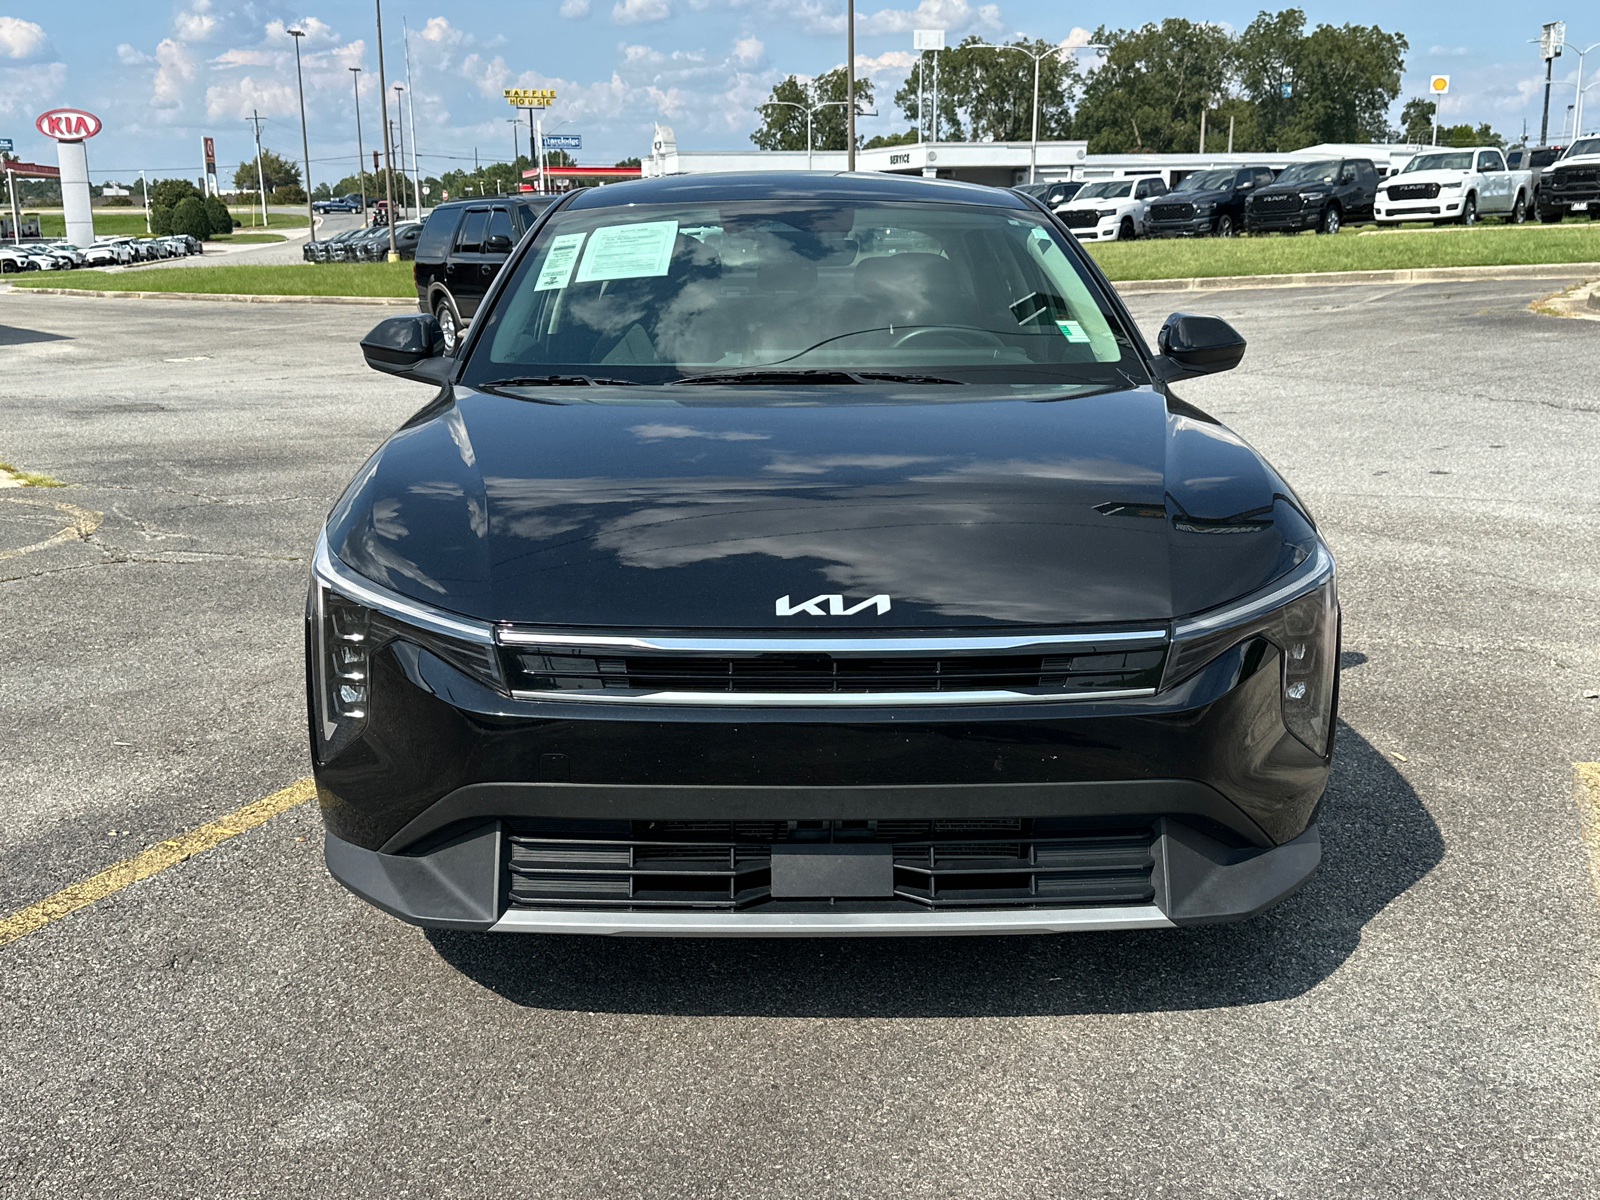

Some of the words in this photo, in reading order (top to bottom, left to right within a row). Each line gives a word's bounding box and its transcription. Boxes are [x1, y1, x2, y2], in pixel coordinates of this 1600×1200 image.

[504, 89, 556, 97] WAFFLE
[509, 98, 552, 106] HOUSE
[47, 116, 91, 134] KIA
[890, 153, 910, 165] SERVICE
[775, 594, 891, 616] KIA
